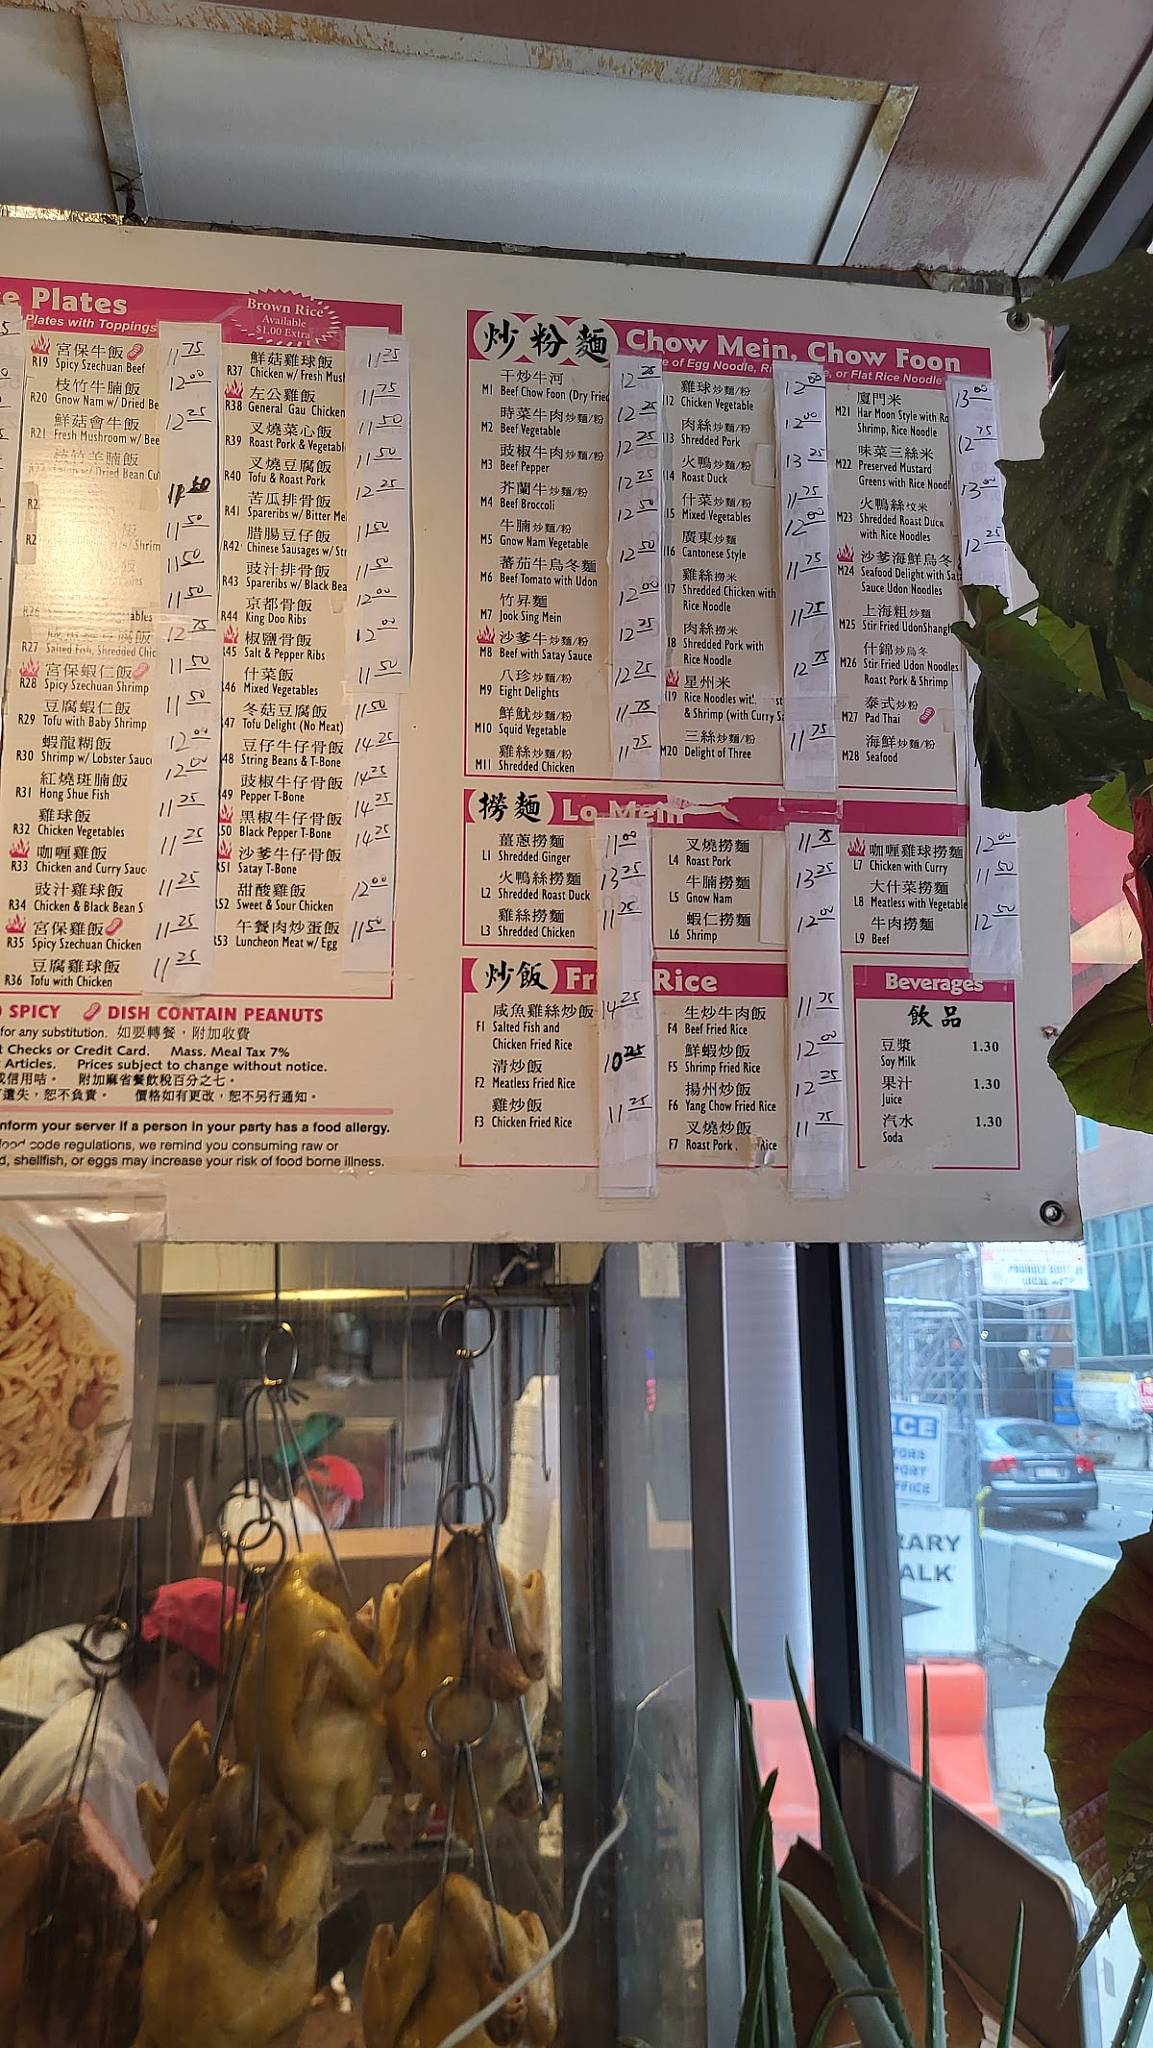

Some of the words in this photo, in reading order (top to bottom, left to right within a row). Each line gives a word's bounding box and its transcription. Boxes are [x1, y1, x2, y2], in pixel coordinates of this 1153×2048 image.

[32, 287, 127, 315] Plates
[247, 298, 290, 314] Brown
[295, 304, 324, 318] Rice
[26, 314, 64, 326] Plates
[68, 318, 94, 328] with
[99, 319, 157, 334] Toppings
[262, 315, 306, 328] Available
[255, 326, 280, 337] $1.00
[282, 328, 310, 339] Extra
[484, 319, 608, 362] 炒粉麵
[56, 342, 124, 361] 宮保牛飯
[627, 329, 709, 355] Chow
[808, 342, 886, 366] Chow
[897, 349, 960, 372] Foon
[32, 356, 48, 367] R19
[55, 358, 79, 373] Spicy
[81, 359, 123, 373] Szechuan
[126, 363, 145, 374] Beef
[670, 360, 684, 368] of
[688, 360, 709, 372] Egg
[713, 360, 758, 372] Noodle,
[836, 370, 848, 378] or
[851, 370, 873, 380] Flat
[876, 371, 899, 381] Rice
[902, 373, 942, 385] Noodle
[225, 399, 243, 412] R38
[248, 401, 282, 415] General
[288, 404, 306, 416] Gau
[311, 404, 345, 418] Chicken
[681, 396, 711, 408] Chicken
[715, 397, 753, 411] Vegetable
[481, 422, 493, 432] M2
[501, 423, 518, 434] Beef
[521, 424, 560, 438] Vegetable
[836, 460, 852, 469] M22
[859, 461, 896, 472] Preserved
[900, 463, 931, 474] Mustard
[224, 470, 241, 482] R40
[248, 471, 268, 484] Tofu
[270, 473, 278, 484] &
[281, 473, 303, 485] Roast
[306, 474, 326, 486] Pork
[682, 548, 723, 559] Cantonese
[727, 549, 746, 561] Style
[480, 609, 492, 620] M7
[500, 611, 519, 623] Jook
[521, 612, 542, 624] Sing
[542, 612, 561, 623] Mein
[479, 685, 492, 695] M9
[500, 686, 521, 698] Eight
[523, 686, 559, 699] Delights
[18, 713, 35, 725] R29
[43, 713, 63, 727] Tofu
[65, 714, 85, 727] with
[87, 715, 109, 731] Baby
[114, 716, 147, 730] Shrimp
[842, 712, 858, 722] M27
[865, 713, 879, 723] Pad
[883, 713, 900, 724] Thai
[842, 751, 859, 761] M28
[866, 752, 898, 763] Seafood
[479, 792, 541, 823] 撈麵
[563, 799, 597, 821] Lo
[12, 824, 30, 835] R32
[37, 824, 73, 837] Chicken
[76, 825, 125, 838] Vegetables
[481, 888, 491, 898] L2
[498, 888, 538, 900] Shredded
[543, 889, 566, 901] Roast
[569, 889, 590, 901] Duck
[669, 893, 679, 903] L5
[687, 893, 711, 904] Gnow
[713, 893, 732, 904] Nam
[237, 899, 262, 911] Sweet
[266, 901, 272, 911] &
[275, 900, 296, 911] Sour
[298, 900, 333, 912] Chicken
[856, 934, 864, 945] L9
[872, 934, 890, 945] Beef
[4, 975, 22, 986] R36
[30, 975, 49, 987] Tofu
[53, 975, 74, 987] with
[76, 976, 113, 989] Chicken
[485, 960, 549, 993] 炒飯
[655, 970, 718, 992] Rice
[886, 973, 984, 995] Beverages
[9, 1005, 60, 1019] SPICY
[108, 1006, 148, 1020] DISH
[158, 1007, 237, 1021] CONTAIN
[244, 1008, 324, 1022] PEANUTS
[908, 1005, 962, 1027] 飲品
[1, 1026, 15, 1038] for
[19, 1027, 38, 1040] any
[42, 1028, 108, 1039] substitution.
[7, 1044, 52, 1056] Checks
[57, 1048, 70, 1056] or
[75, 1045, 113, 1056] Credit
[117, 1045, 150, 1056] Card.
[171, 1046, 206, 1057] Mass.
[211, 1046, 242, 1057] Meal
[246, 1046, 266, 1057] Tax
[270, 1046, 290, 1058] 7%
[972, 1041, 999, 1052] 1.30
[5, 1059, 56, 1070] Articles.
[77, 1059, 113, 1071] Prices
[117, 1059, 162, 1074] subject
[167, 1061, 180, 1072] to
[184, 1060, 229, 1074] change
[233, 1061, 282, 1072] without
[286, 1061, 327, 1073] notice.
[881, 1056, 895, 1068] Soy
[898, 1056, 916, 1068] Milk
[475, 1078, 484, 1088] F2
[492, 1078, 529, 1089] Meatless
[532, 1078, 555, 1089] Fried
[558, 1078, 575, 1089] Rice
[882, 1076, 912, 1090] 果汁
[974, 1079, 1000, 1090] 1.30
[668, 1100, 678, 1111] F6
[686, 1101, 706, 1113] Yang
[709, 1101, 732, 1112] Chow
[735, 1101, 756, 1112] Fried
[759, 1101, 776, 1112] Rice
[882, 1094, 902, 1107] Juice
[883, 1114, 913, 1127] 汽水
[975, 1117, 1002, 1127] 1.30
[43, 1122, 70, 1135] your
[75, 1121, 116, 1131] server
[120, 1121, 128, 1132] if
[131, 1122, 139, 1132] a
[143, 1122, 187, 1135] person
[191, 1121, 201, 1132] in
[208, 1122, 235, 1136] your
[239, 1122, 271, 1136] party
[275, 1121, 298, 1133] has
[301, 1123, 309, 1133] a
[313, 1121, 341, 1133] food
[345, 1122, 390, 1136] allergy.
[883, 1132, 903, 1143] Soda
